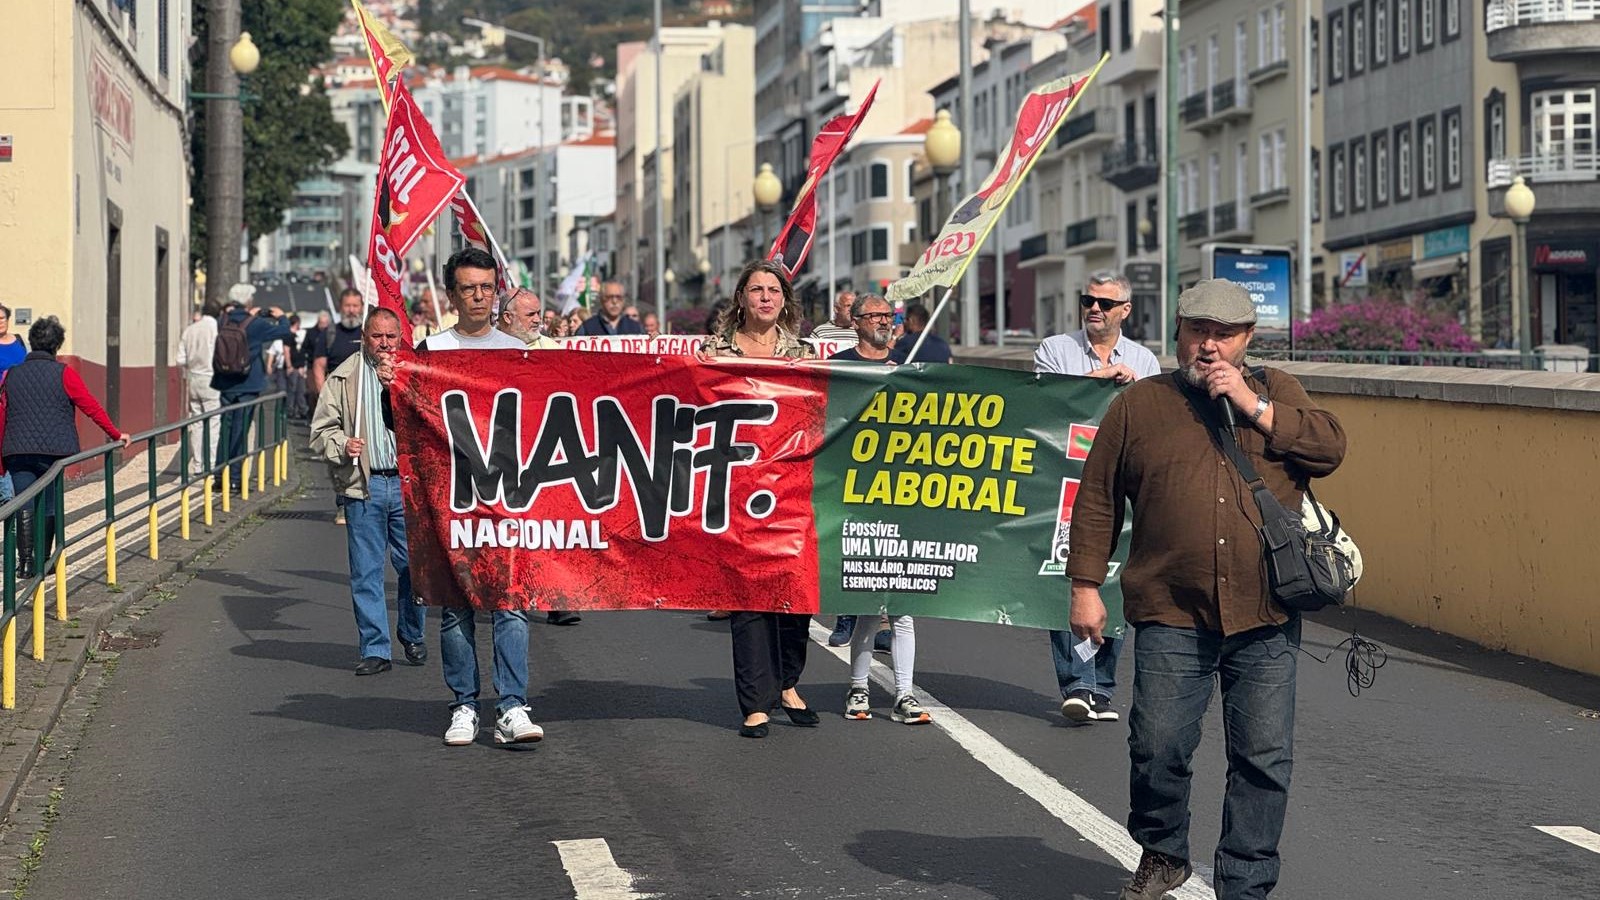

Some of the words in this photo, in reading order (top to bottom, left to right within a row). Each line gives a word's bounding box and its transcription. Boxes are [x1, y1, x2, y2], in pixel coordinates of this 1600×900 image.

[386, 125, 427, 205] STAL
[859, 391, 1005, 428] ABAIXO
[851, 429, 880, 462] O
[883, 430, 1037, 474] PACOTE
[843, 468, 1026, 516] LABORAL
[450, 518, 608, 549] NACIONAL
[842, 518, 849, 537] É
[849, 520, 901, 538] POSSÍVEL
[841, 537, 871, 556] UMA
[873, 538, 909, 558] VIDA
[911, 540, 979, 563] MELHOR
[843, 560, 863, 573] MAIS
[863, 559, 906, 576] SALÁRIO,
[906, 562, 954, 578] DIREITOS
[843, 575, 849, 588] E
[849, 576, 888, 592] SERVIÇOS
[889, 574, 937, 591] PÚBLICOS
